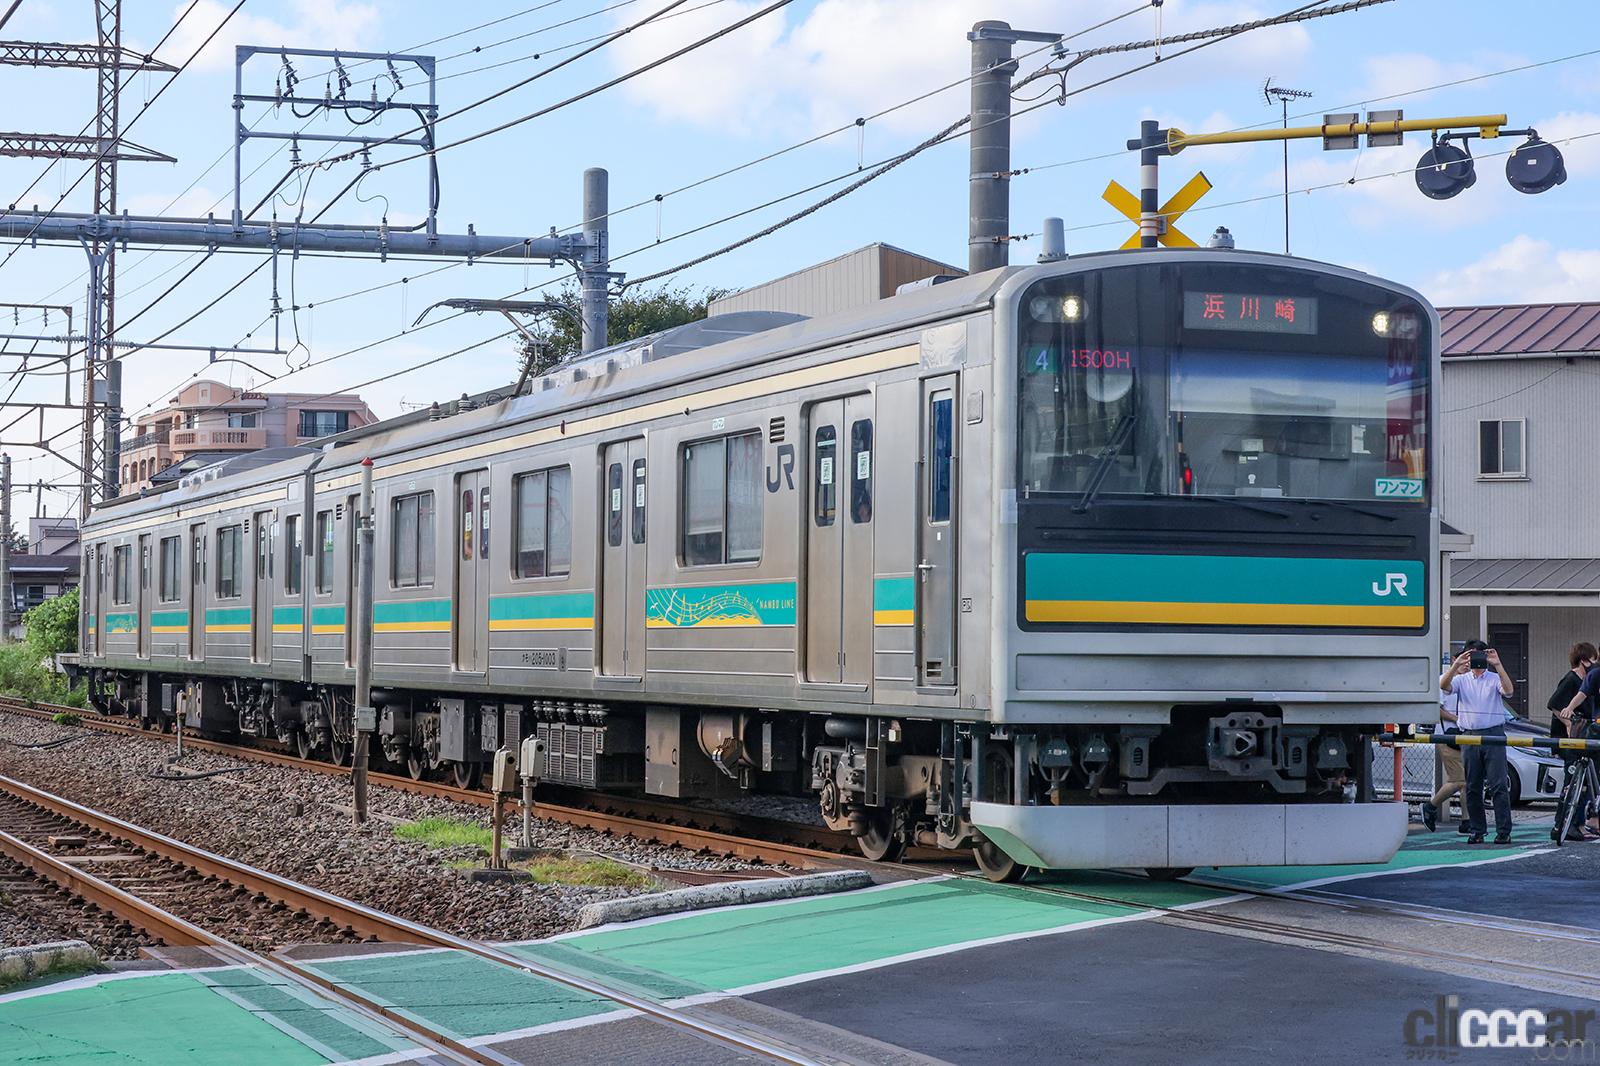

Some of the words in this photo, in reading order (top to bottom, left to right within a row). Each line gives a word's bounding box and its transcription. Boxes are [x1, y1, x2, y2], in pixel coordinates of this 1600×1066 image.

[1204, 294, 1296, 323] 浜川崎
[1036, 350, 1048, 370] 4
[1071, 349, 1130, 369] 1500H
[766, 443, 794, 493] JR
[1377, 480, 1421, 495] ワンマン
[1372, 573, 1407, 596] JR
[781, 598, 795, 609] LINE
